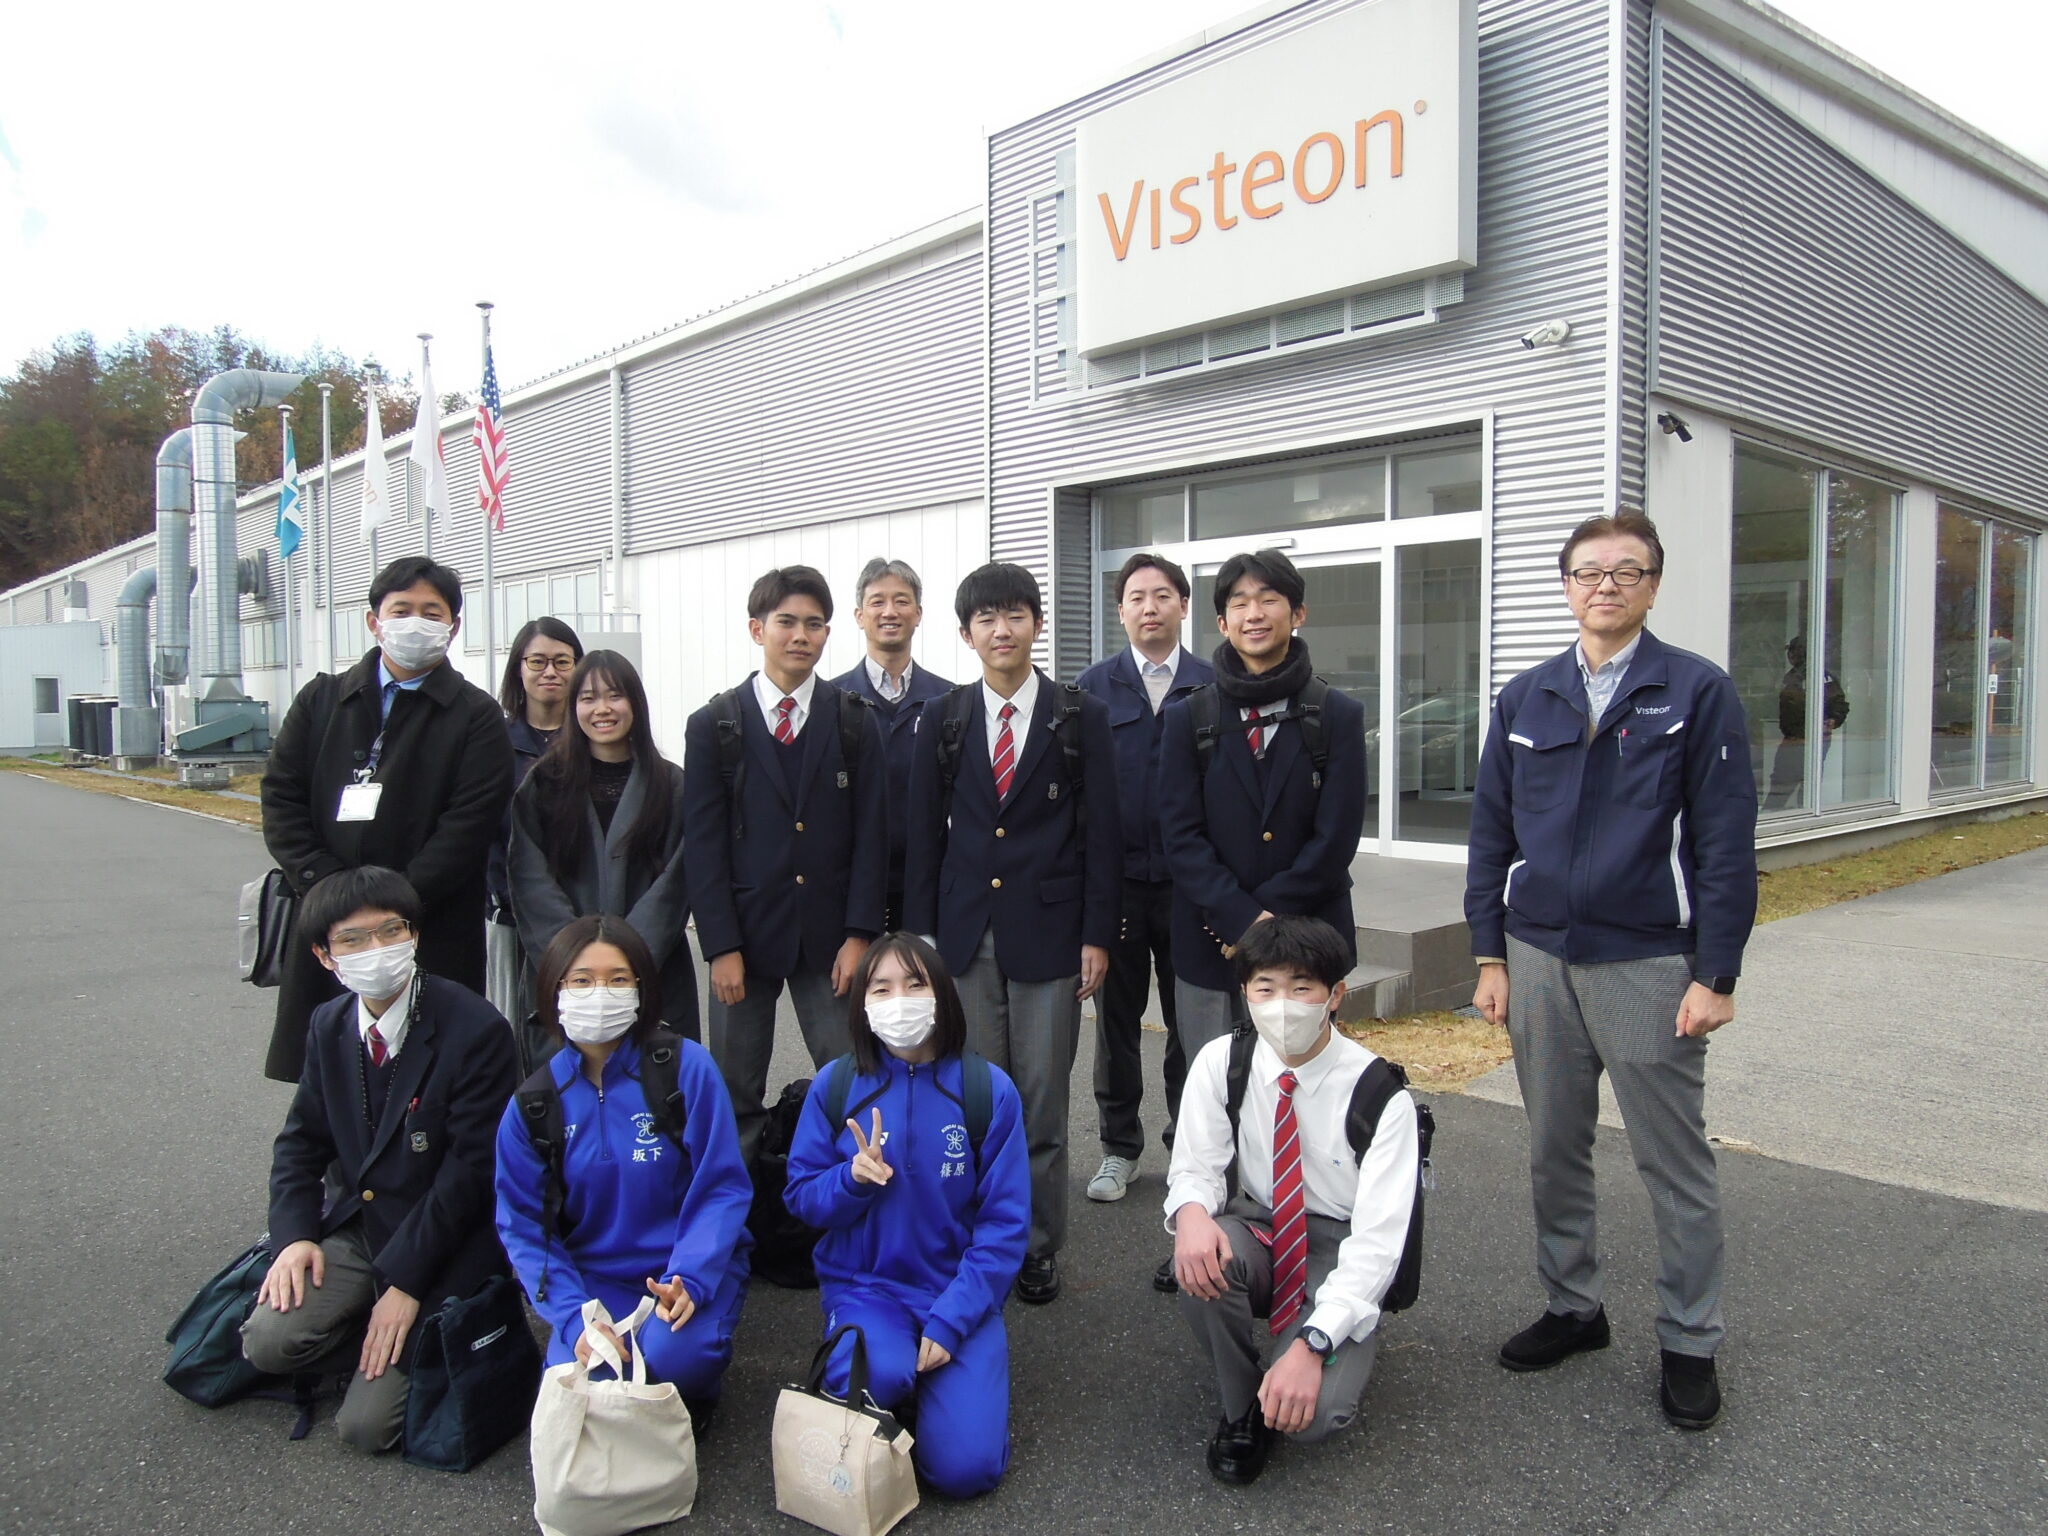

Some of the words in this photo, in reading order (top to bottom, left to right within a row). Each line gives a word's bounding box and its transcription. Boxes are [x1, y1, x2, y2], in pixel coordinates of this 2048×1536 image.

[1098, 108, 1404, 262] Visteon
[1635, 705, 1672, 716] Visteon
[632, 1146, 663, 1162] 坂下
